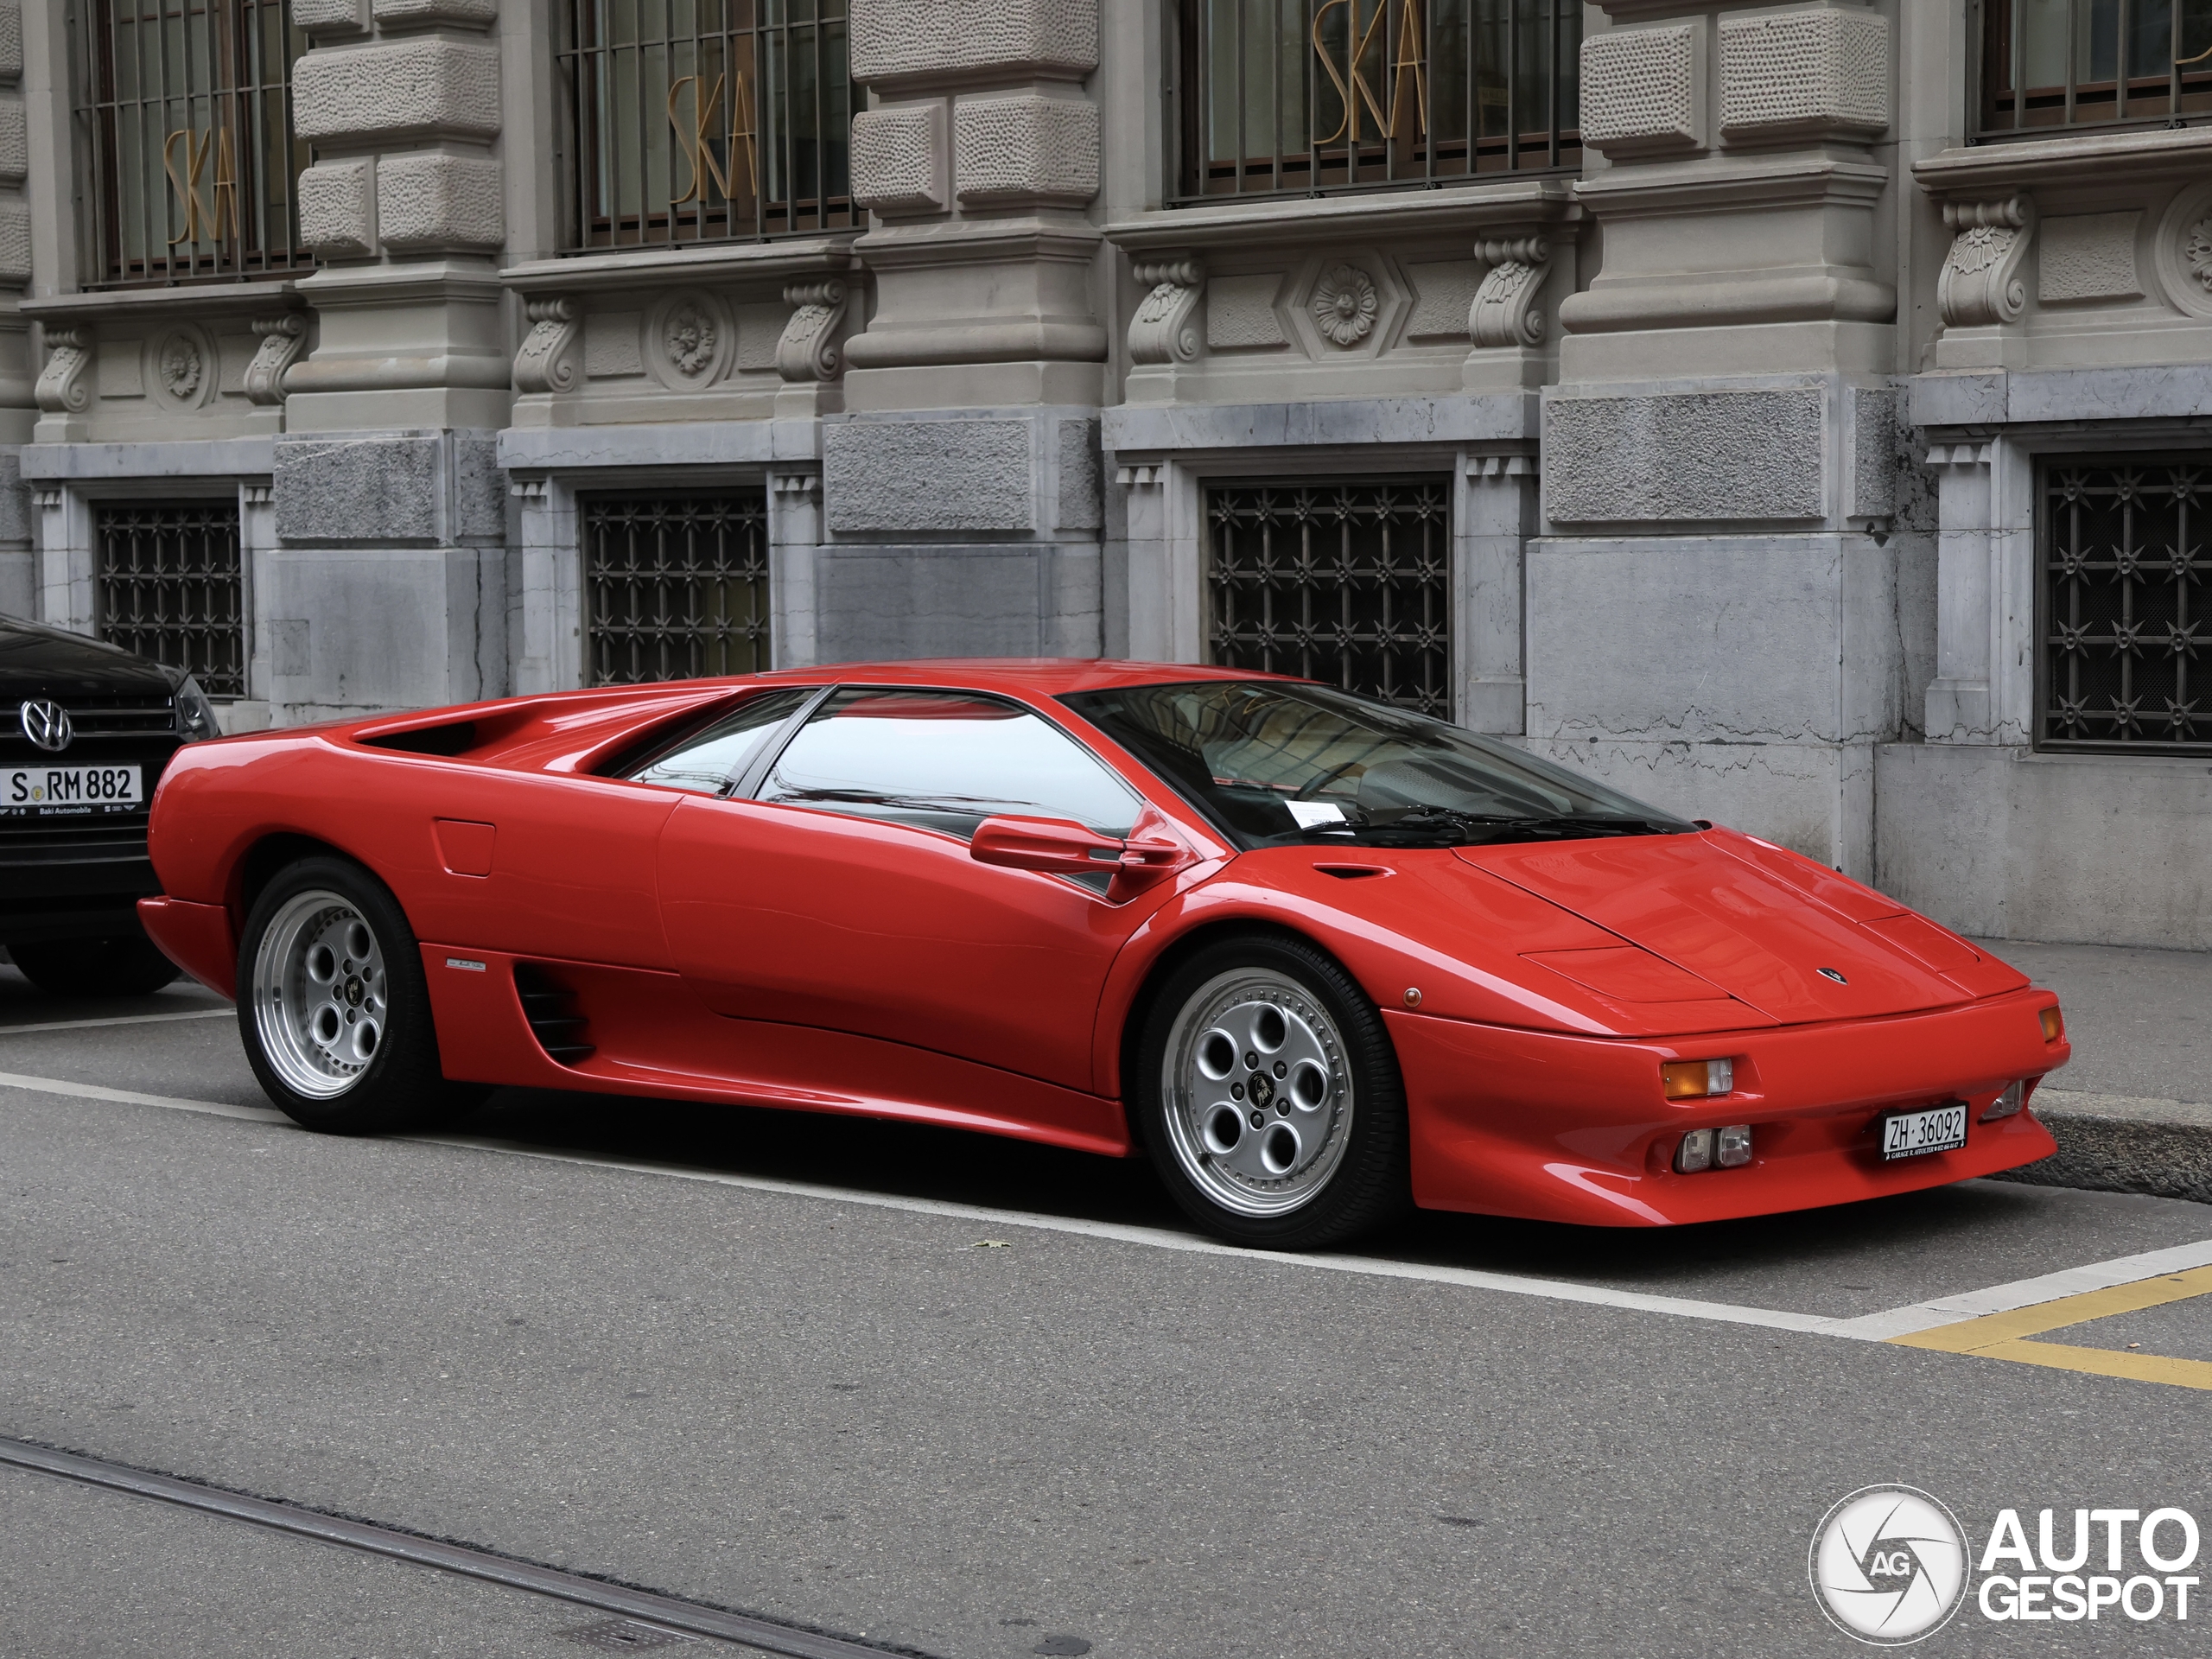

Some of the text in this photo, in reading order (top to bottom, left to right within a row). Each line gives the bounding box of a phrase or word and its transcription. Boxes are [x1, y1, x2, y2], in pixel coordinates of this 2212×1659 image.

[1313, 0, 1427, 145] SKA
[668, 71, 756, 204] SKA
[164, 127, 238, 244] SKA
[11, 769, 131, 801] S RM 882
[54, 806, 92, 815] Automobile
[1891, 1150, 1909, 1159] GARAGE
